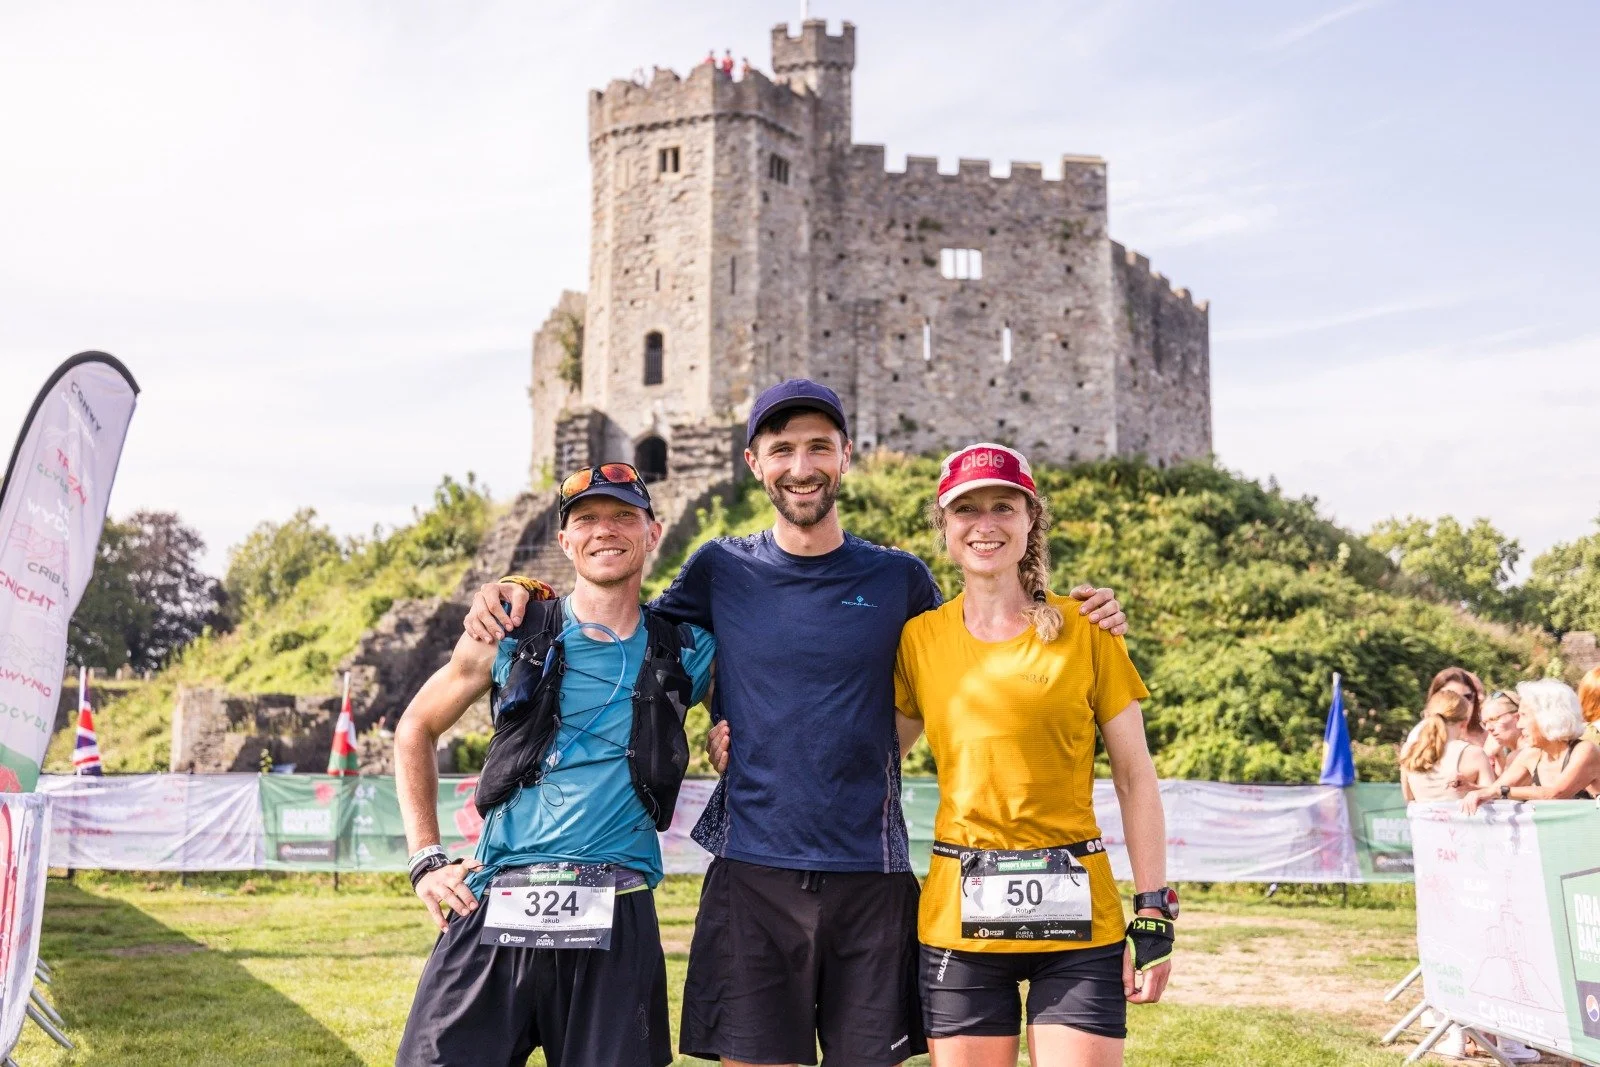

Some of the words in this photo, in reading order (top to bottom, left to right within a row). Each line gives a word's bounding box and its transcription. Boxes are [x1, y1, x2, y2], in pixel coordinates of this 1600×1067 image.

[70, 381, 102, 432] CONWY
[960, 450, 1005, 472] ciele
[27, 561, 61, 585] CRIB
[525, 890, 580, 917] 324
[1007, 879, 1043, 906] 50
[1132, 920, 1166, 934] LEKI
